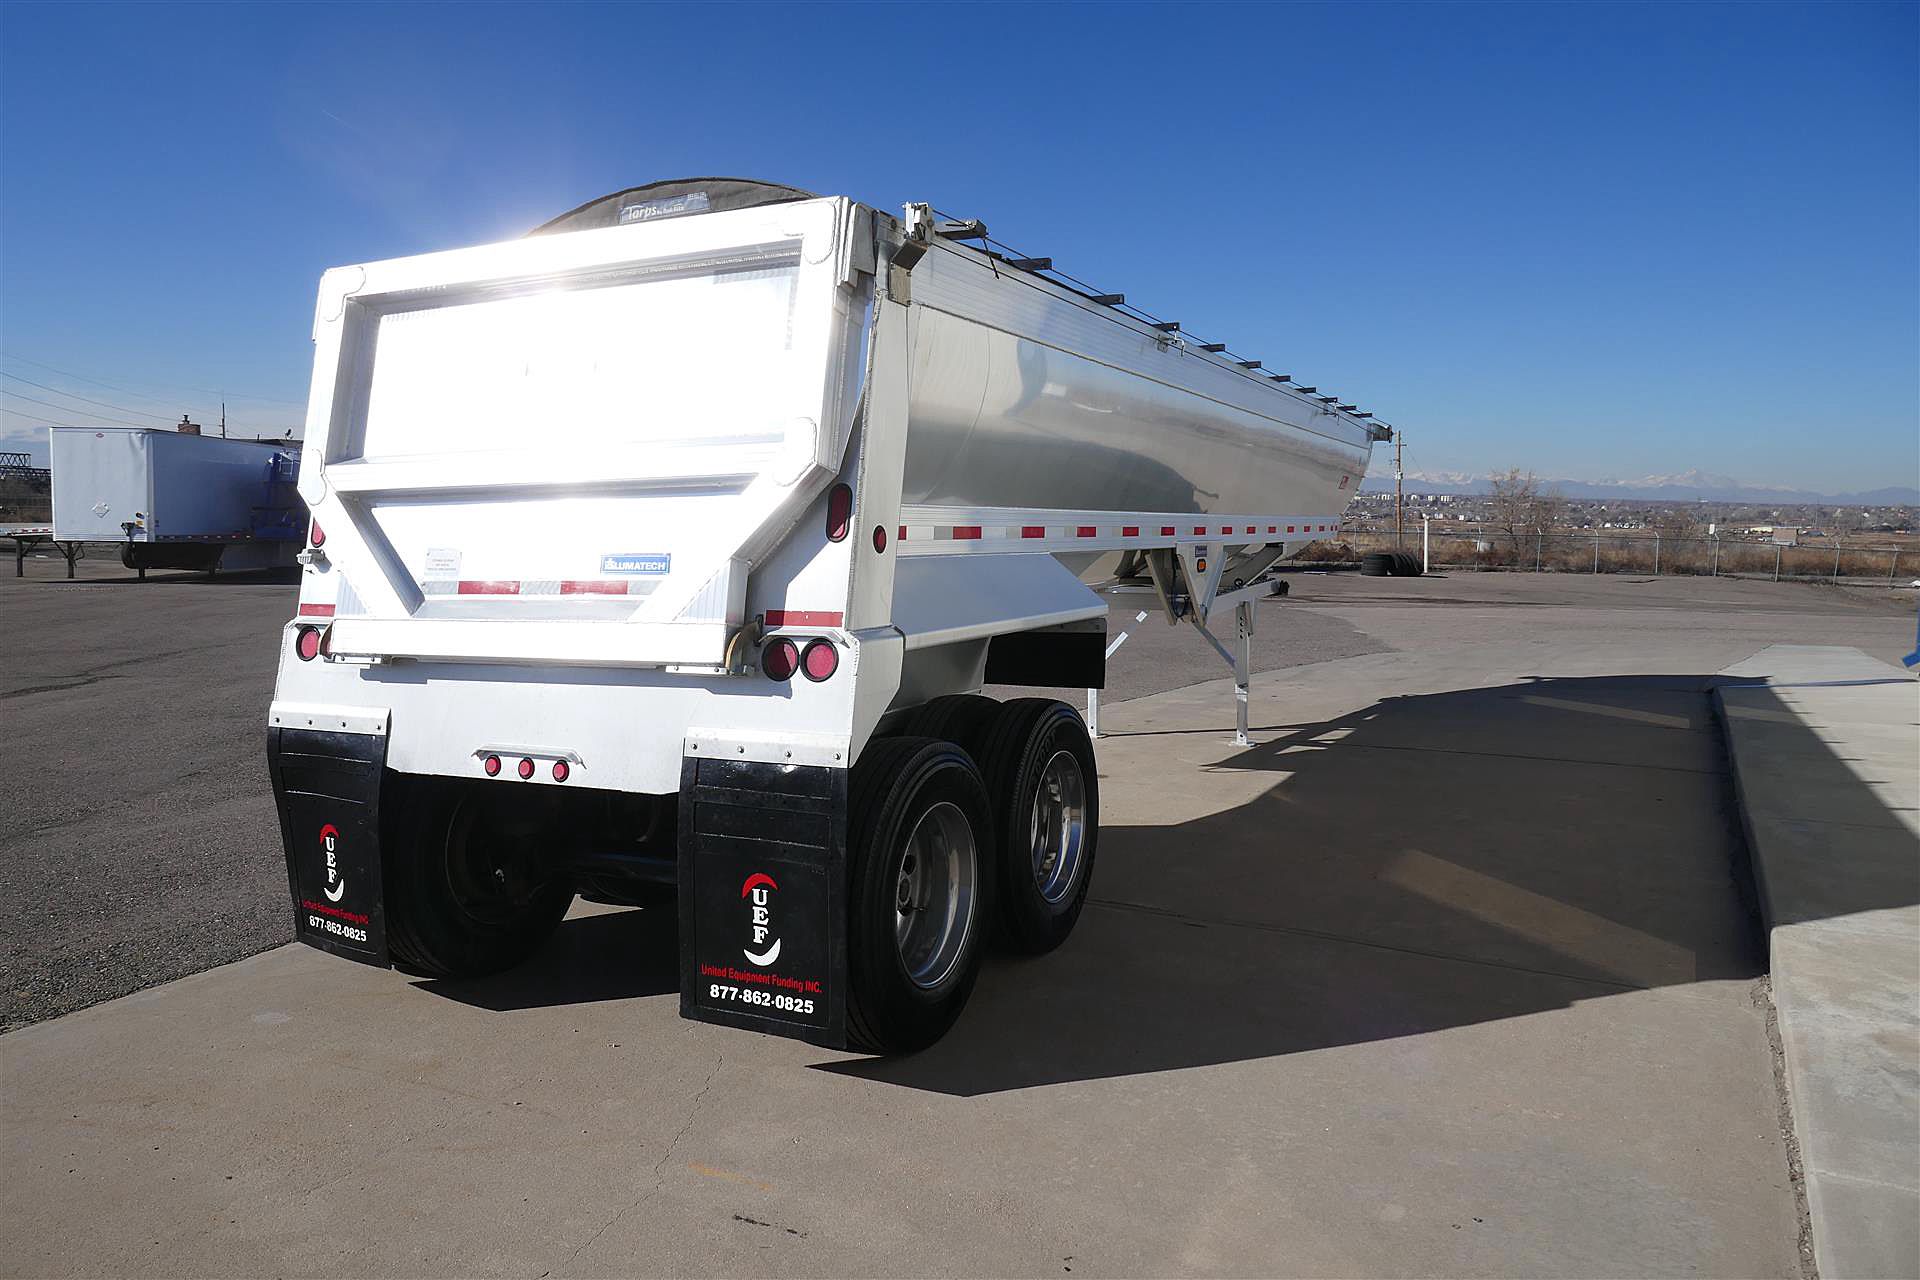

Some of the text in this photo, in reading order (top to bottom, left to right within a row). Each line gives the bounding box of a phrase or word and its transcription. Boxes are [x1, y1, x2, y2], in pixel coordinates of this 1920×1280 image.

[624, 205, 657, 220] Tarps
[325, 836, 337, 884] UEF
[752, 888, 769, 944] UEF
[701, 963, 727, 977] United
[728, 968, 770, 984] Equipment
[772, 974, 803, 992] Funding
